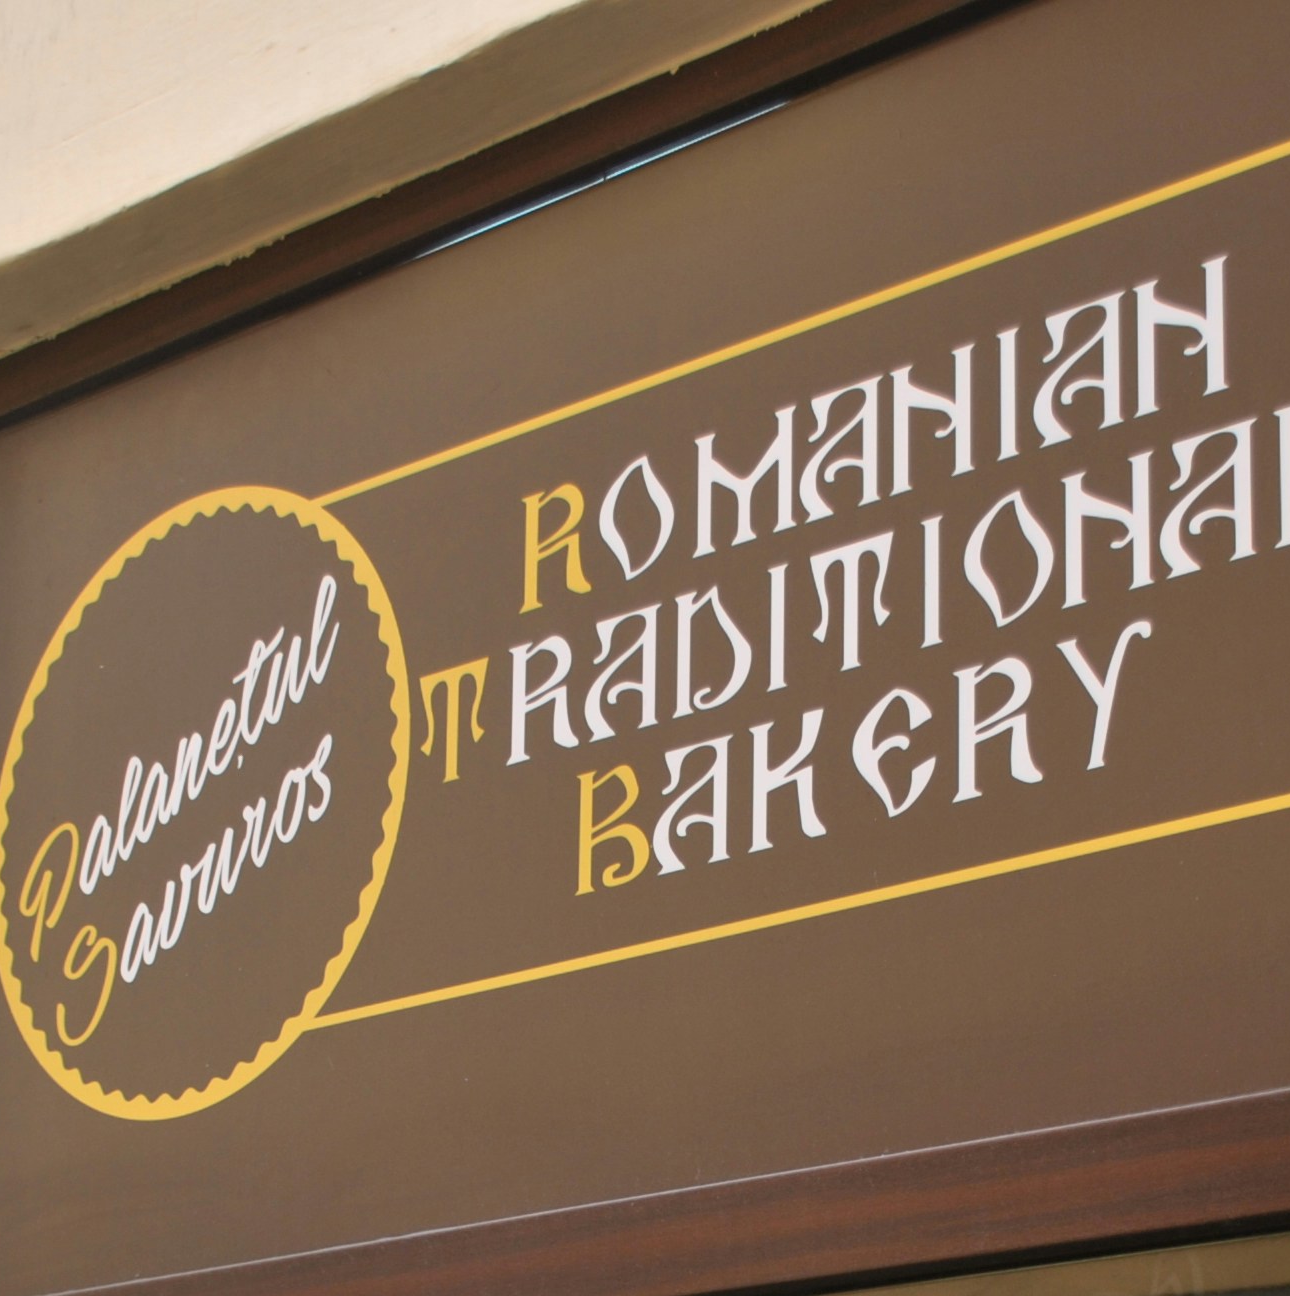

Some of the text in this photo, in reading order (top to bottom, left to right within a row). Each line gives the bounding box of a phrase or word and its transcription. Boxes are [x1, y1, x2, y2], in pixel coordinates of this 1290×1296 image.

[519, 253, 1229, 615] ROMANIAN
[55, 732, 334, 1048] Savuros
[574, 619, 1153, 897] BAKERY
